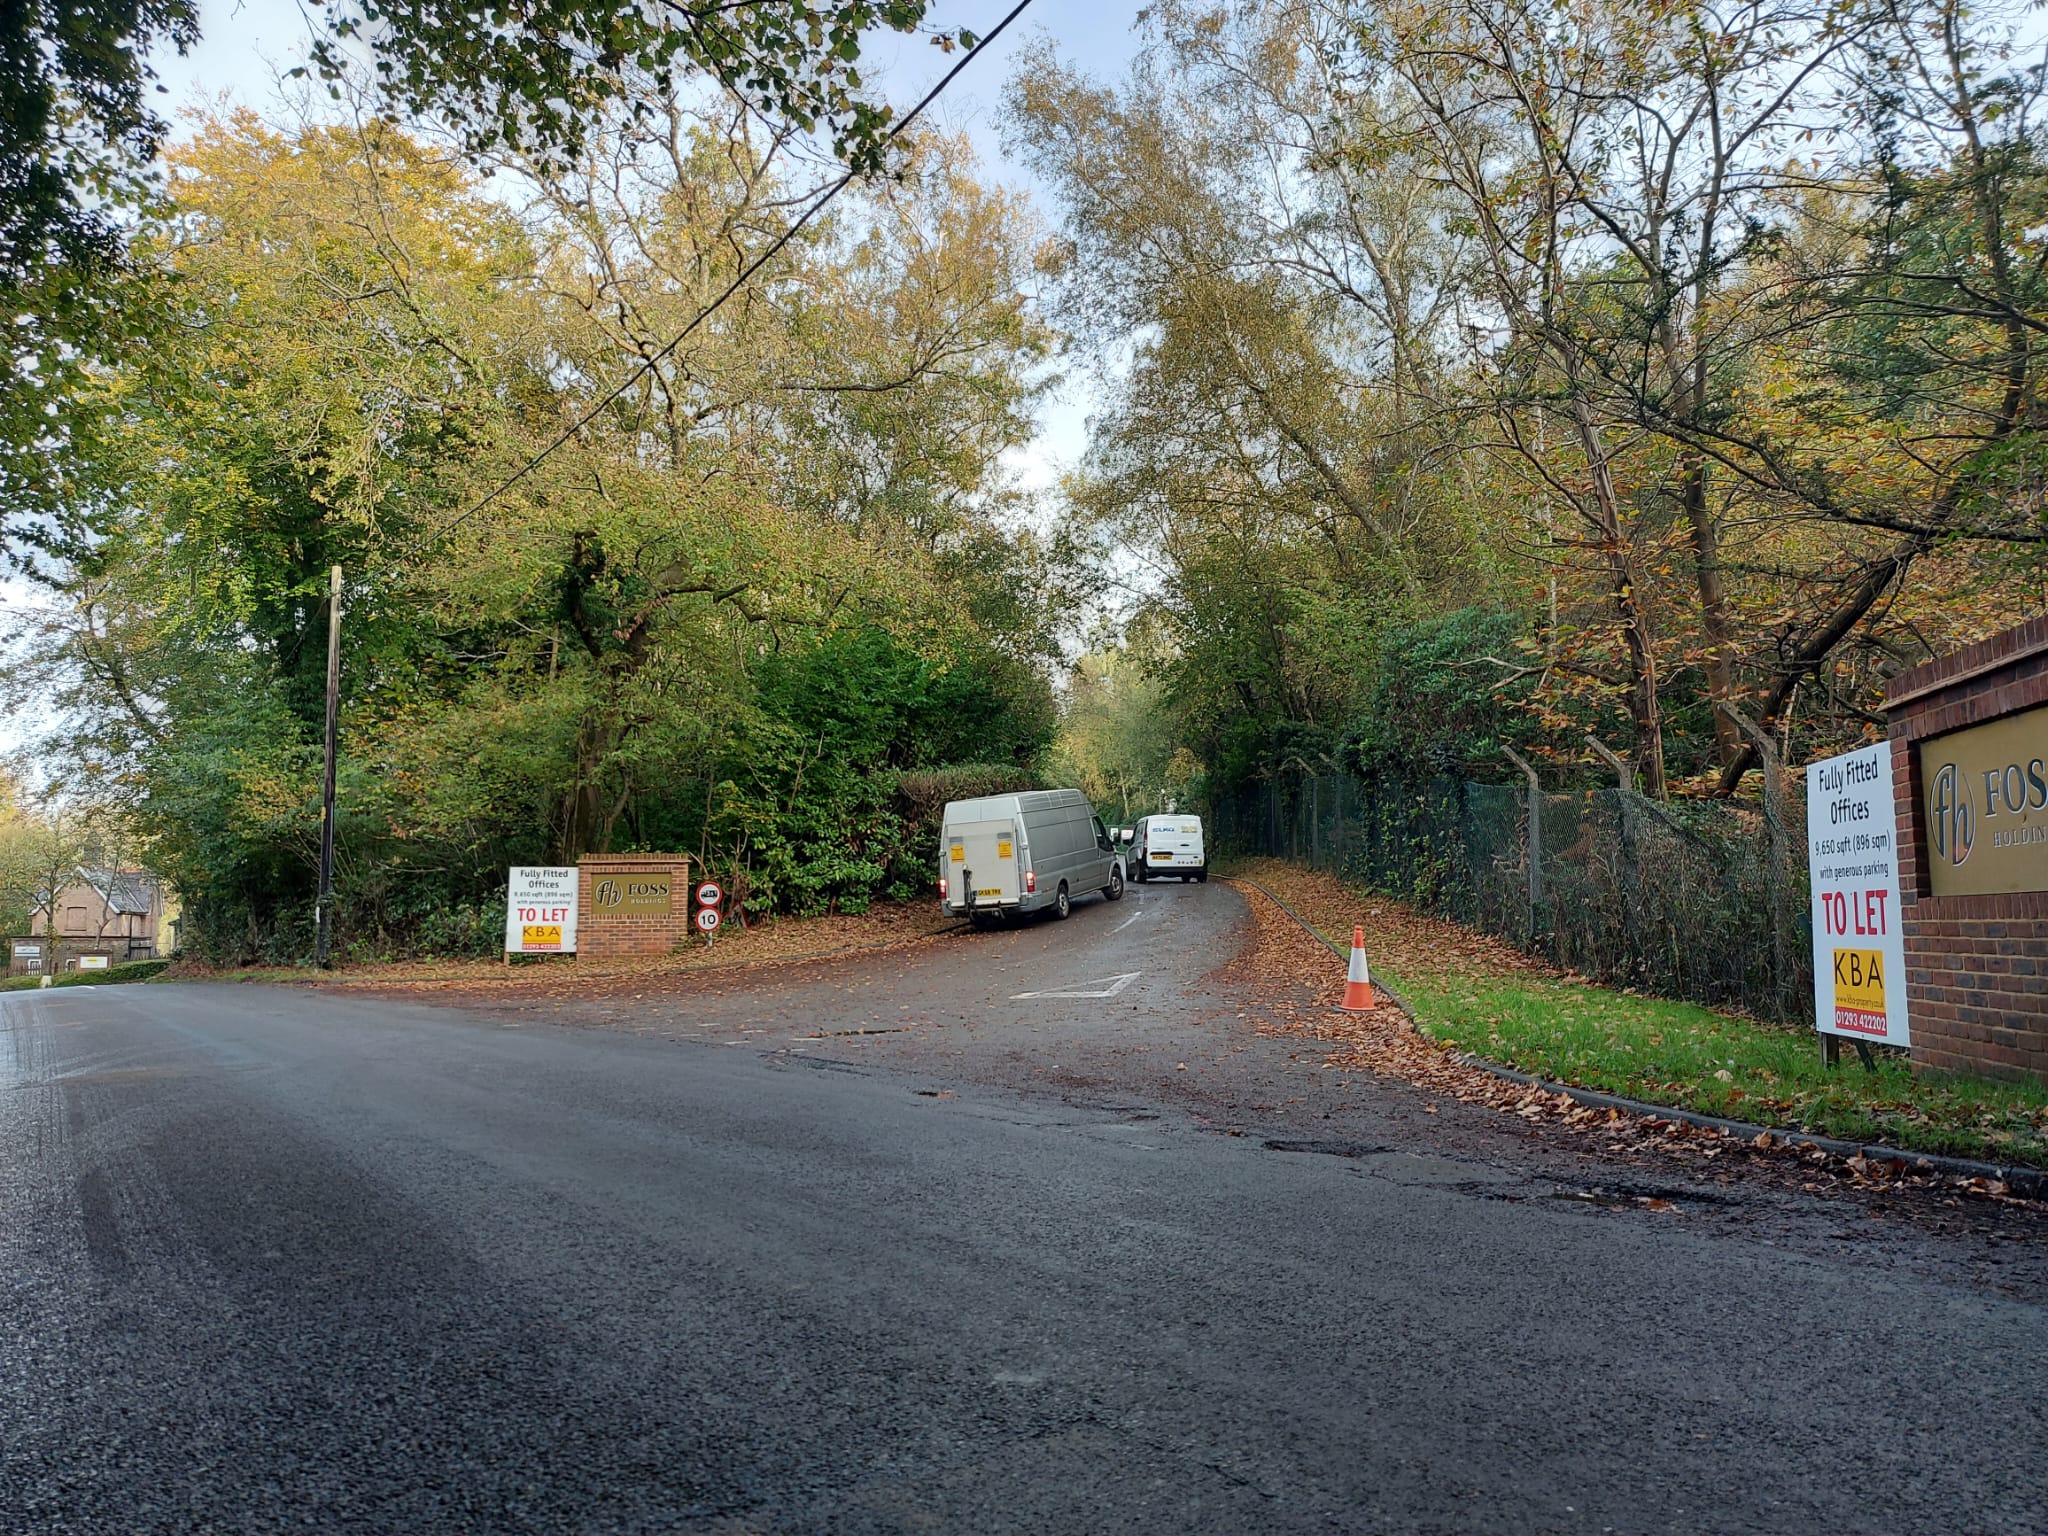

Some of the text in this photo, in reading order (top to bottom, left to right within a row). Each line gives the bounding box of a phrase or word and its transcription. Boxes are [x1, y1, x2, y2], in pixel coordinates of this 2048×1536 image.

[1819, 753, 1879, 794] Fully Fitted
[1982, 758, 2048, 818] FOS
[1830, 797, 1870, 825] Offices
[1815, 829, 1891, 857] 9,650 sqft (896 sqm)
[1994, 825, 2048, 848] HOLDIN
[520, 869, 569, 879] Fully Fitted
[1820, 860, 1889, 881] with generous parking
[528, 880, 560, 889] Offices
[628, 883, 670, 897] FOSS
[517, 908, 569, 922] TO LET
[701, 914, 716, 925] 10
[1821, 889, 1888, 936] TO LET
[523, 926, 560, 937] KBA
[1833, 951, 1883, 989] KBA
[1836, 1010, 1887, 1031] 01293 422202
